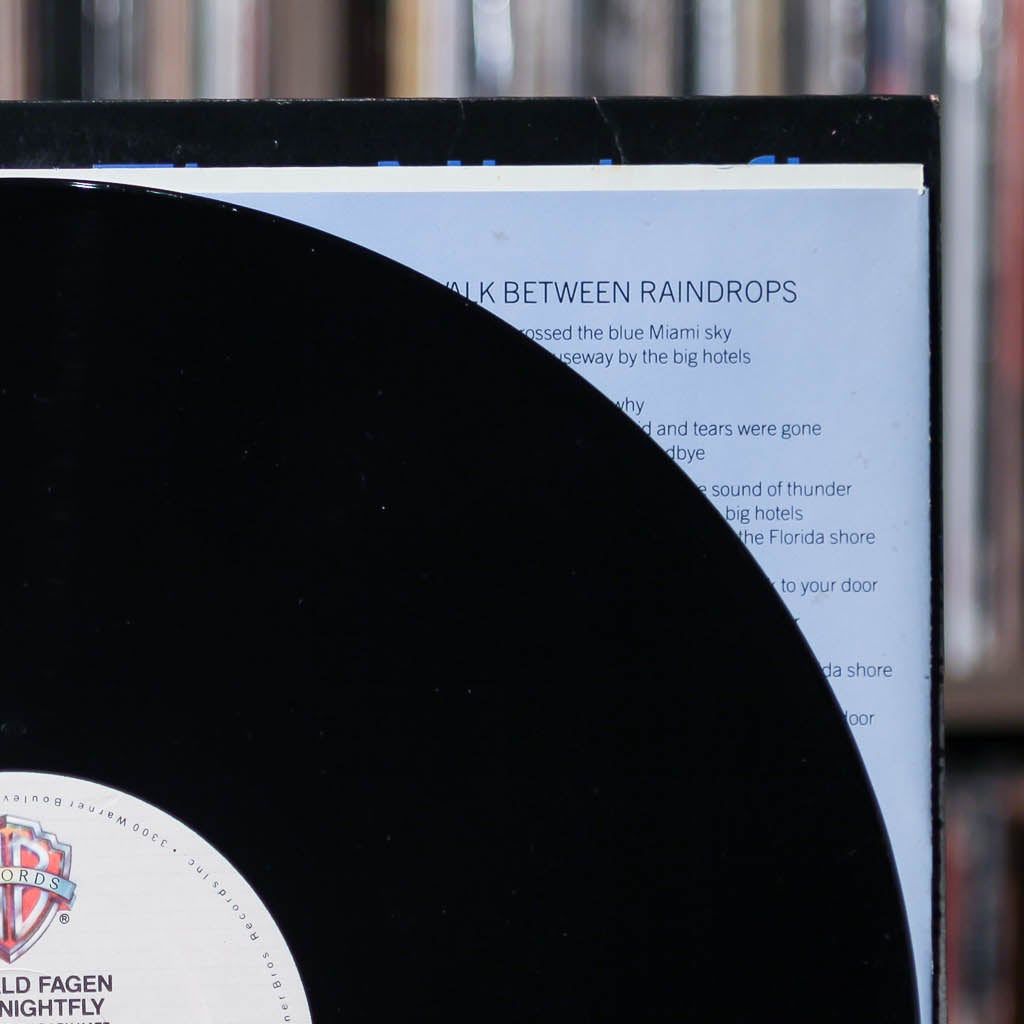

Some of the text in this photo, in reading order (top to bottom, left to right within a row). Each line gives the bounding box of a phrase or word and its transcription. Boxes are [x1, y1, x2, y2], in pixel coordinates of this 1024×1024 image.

[504, 280, 629, 303] BETWEEN
[641, 280, 797, 303] RAINDROPS
[577, 324, 603, 340] the
[608, 324, 644, 340] blue
[649, 323, 699, 340] Miami
[704, 324, 731, 343] sky
[618, 348, 637, 368] by
[642, 348, 668, 364] the
[673, 348, 698, 368] big
[703, 348, 751, 364] hotels
[656, 420, 687, 437] and
[693, 421, 732, 436] tears
[737, 424, 776, 436] were
[781, 423, 821, 439] gone
[711, 481, 761, 497] sound
[767, 480, 782, 497] of
[787, 481, 852, 496] thunder
[769, 528, 824, 545] Florida
[829, 528, 875, 544] shore
[781, 578, 796, 593] to
[800, 580, 836, 596] your
[840, 577, 878, 592] door
[38, 974, 112, 993] FAGEN
